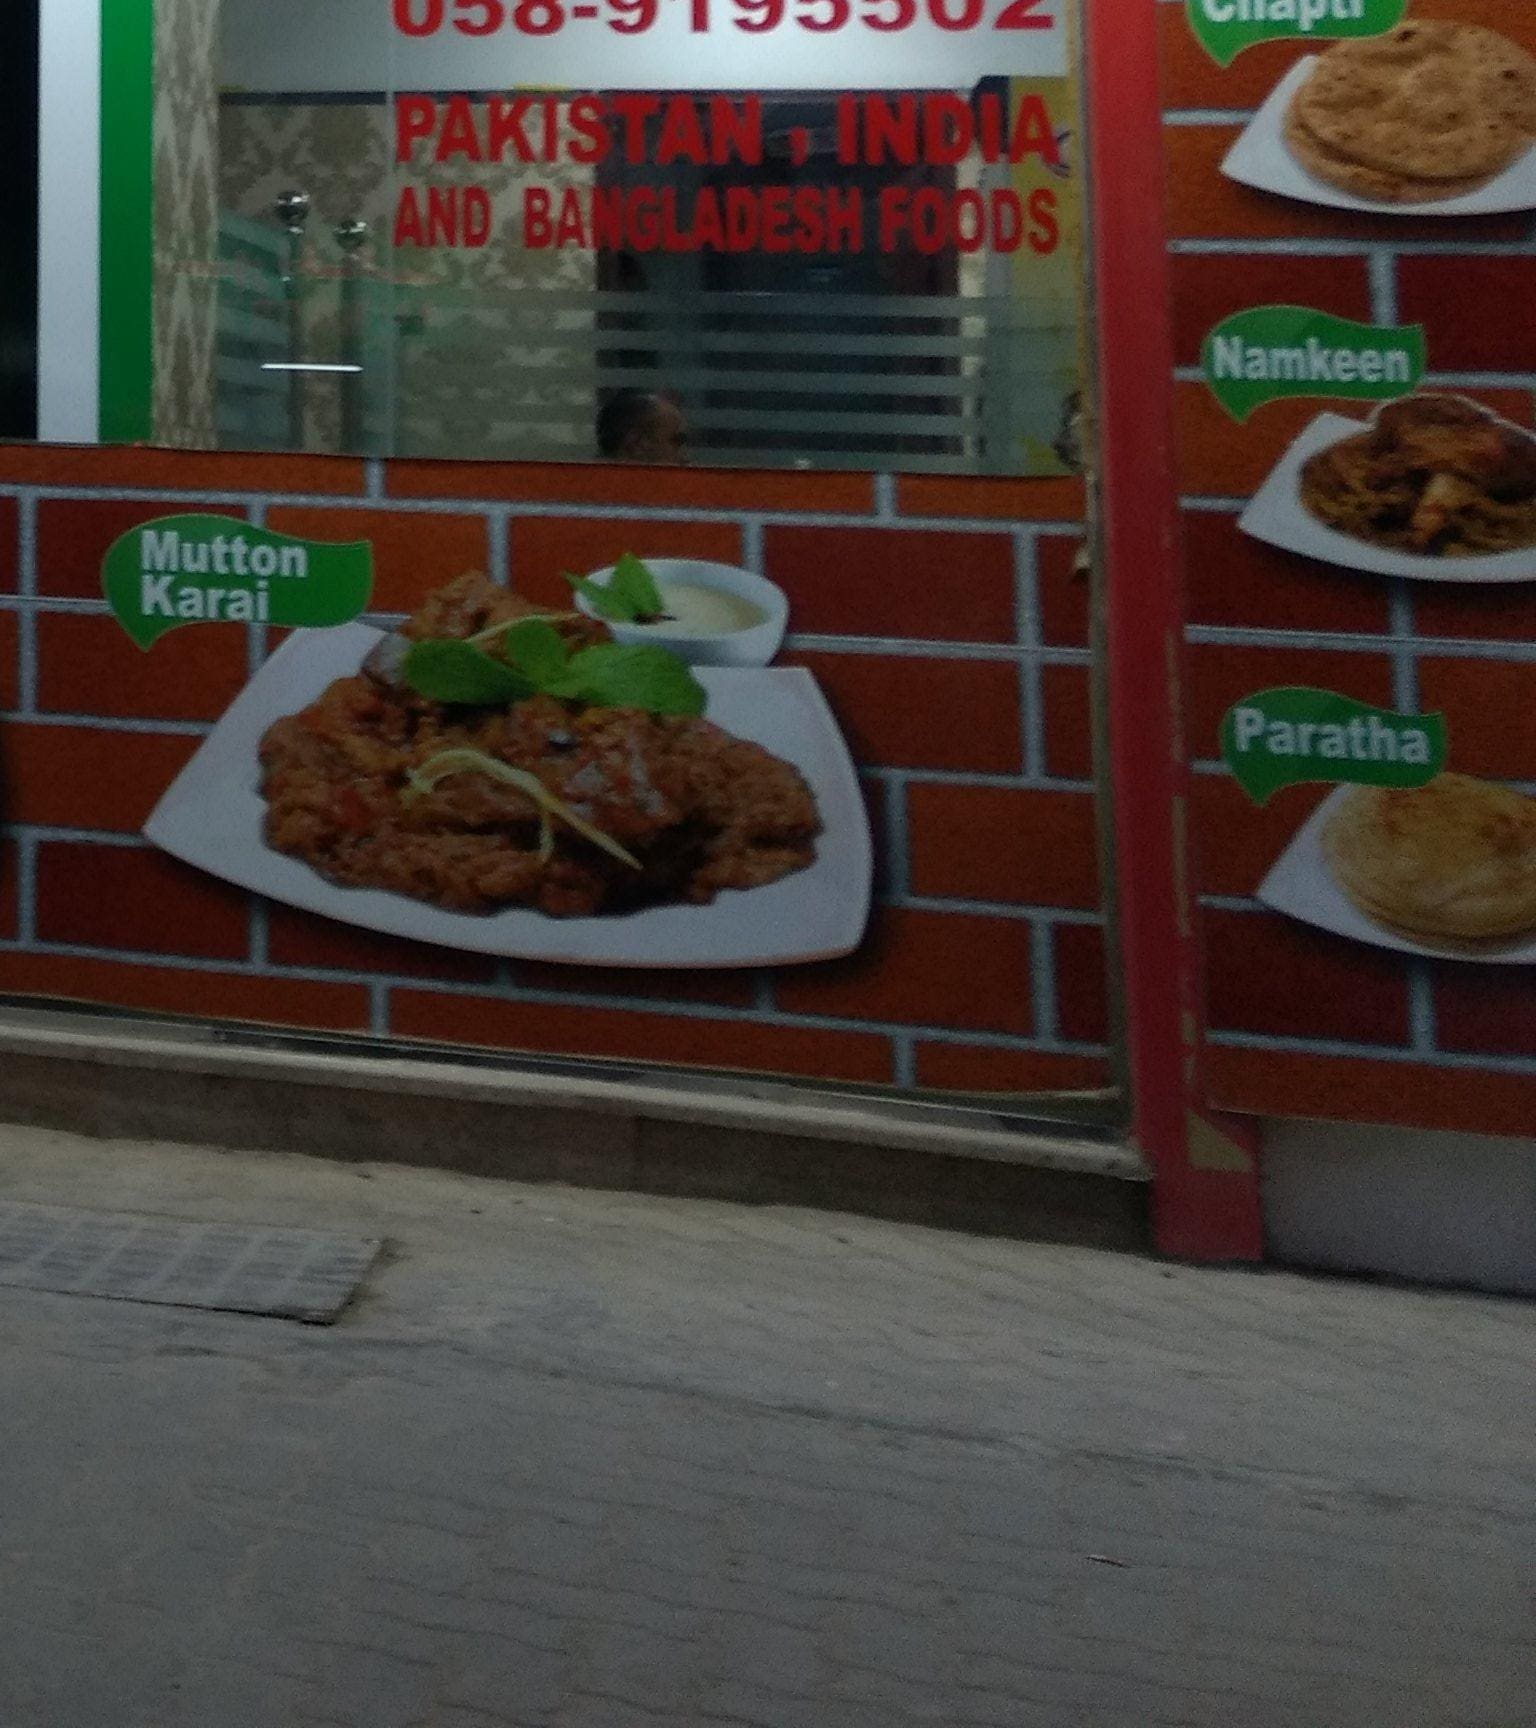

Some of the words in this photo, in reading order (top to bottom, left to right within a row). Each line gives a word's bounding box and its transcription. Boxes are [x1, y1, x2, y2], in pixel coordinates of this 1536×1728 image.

[394, 92, 763, 166] PAKISTAN
[836, 92, 1061, 166] INDIA
[393, 187, 491, 249] AND
[522, 185, 863, 253] BANGLADESH
[879, 187, 1059, 254] FOODS
[1213, 336, 1411, 384] Namkeen
[141, 530, 308, 578] Mutton
[141, 574, 269, 621] Karai
[1234, 709, 1432, 764] Paratha
